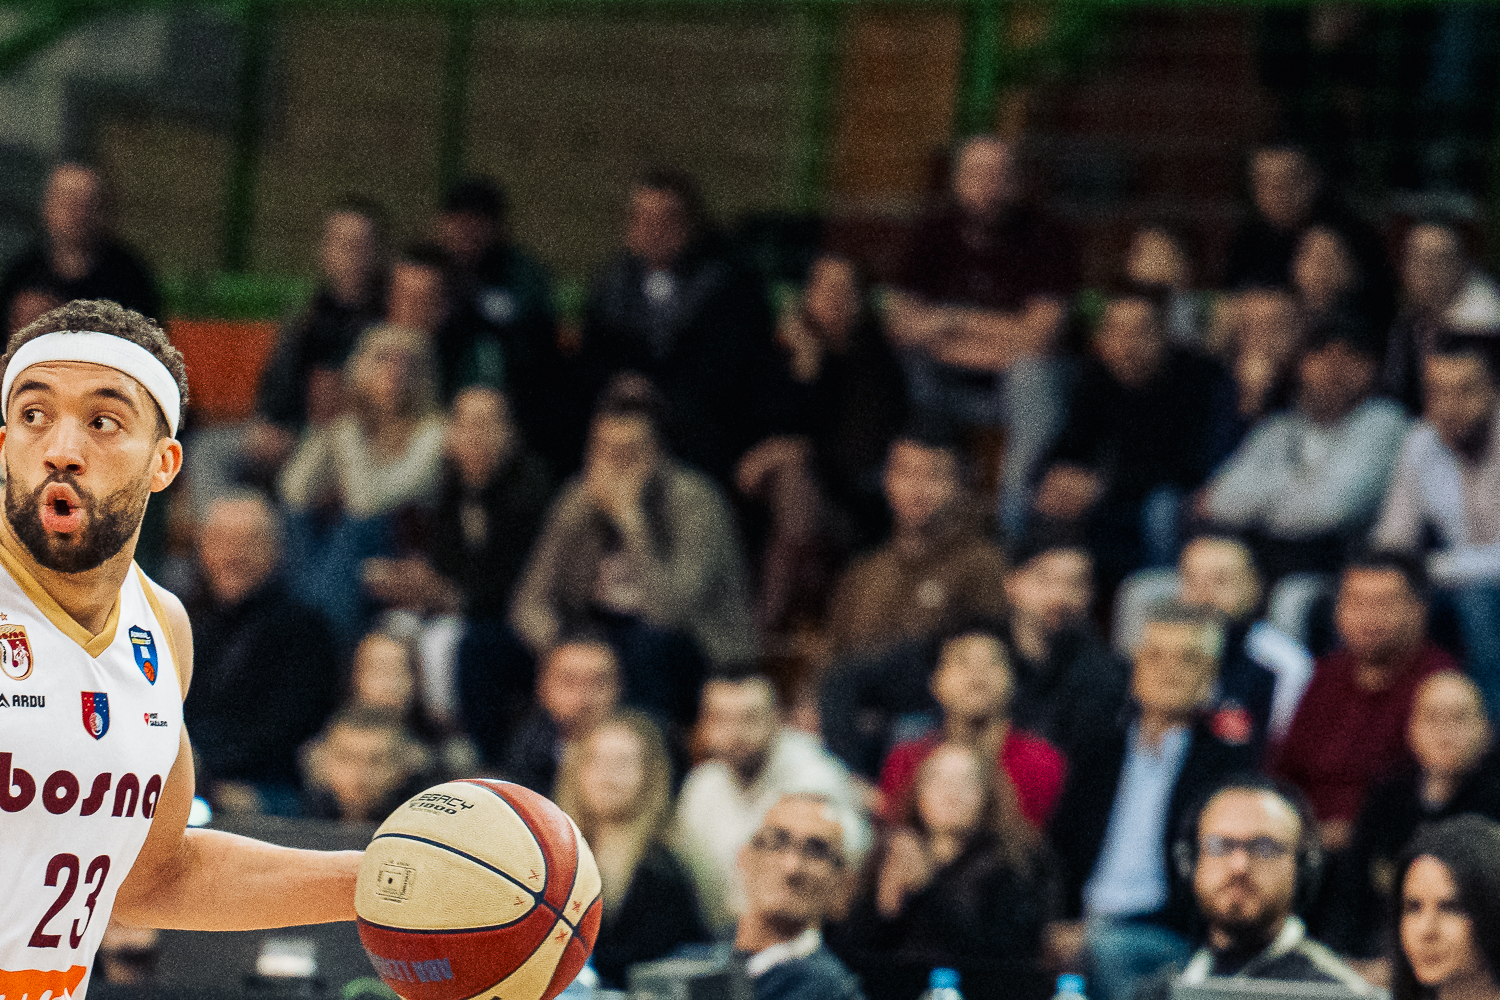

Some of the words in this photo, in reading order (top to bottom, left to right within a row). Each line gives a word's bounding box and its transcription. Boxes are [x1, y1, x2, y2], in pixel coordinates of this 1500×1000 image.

[11, 694, 46, 708] ARDU
[411, 793, 475, 811] EGACY
[27, 852, 111, 950] 23
